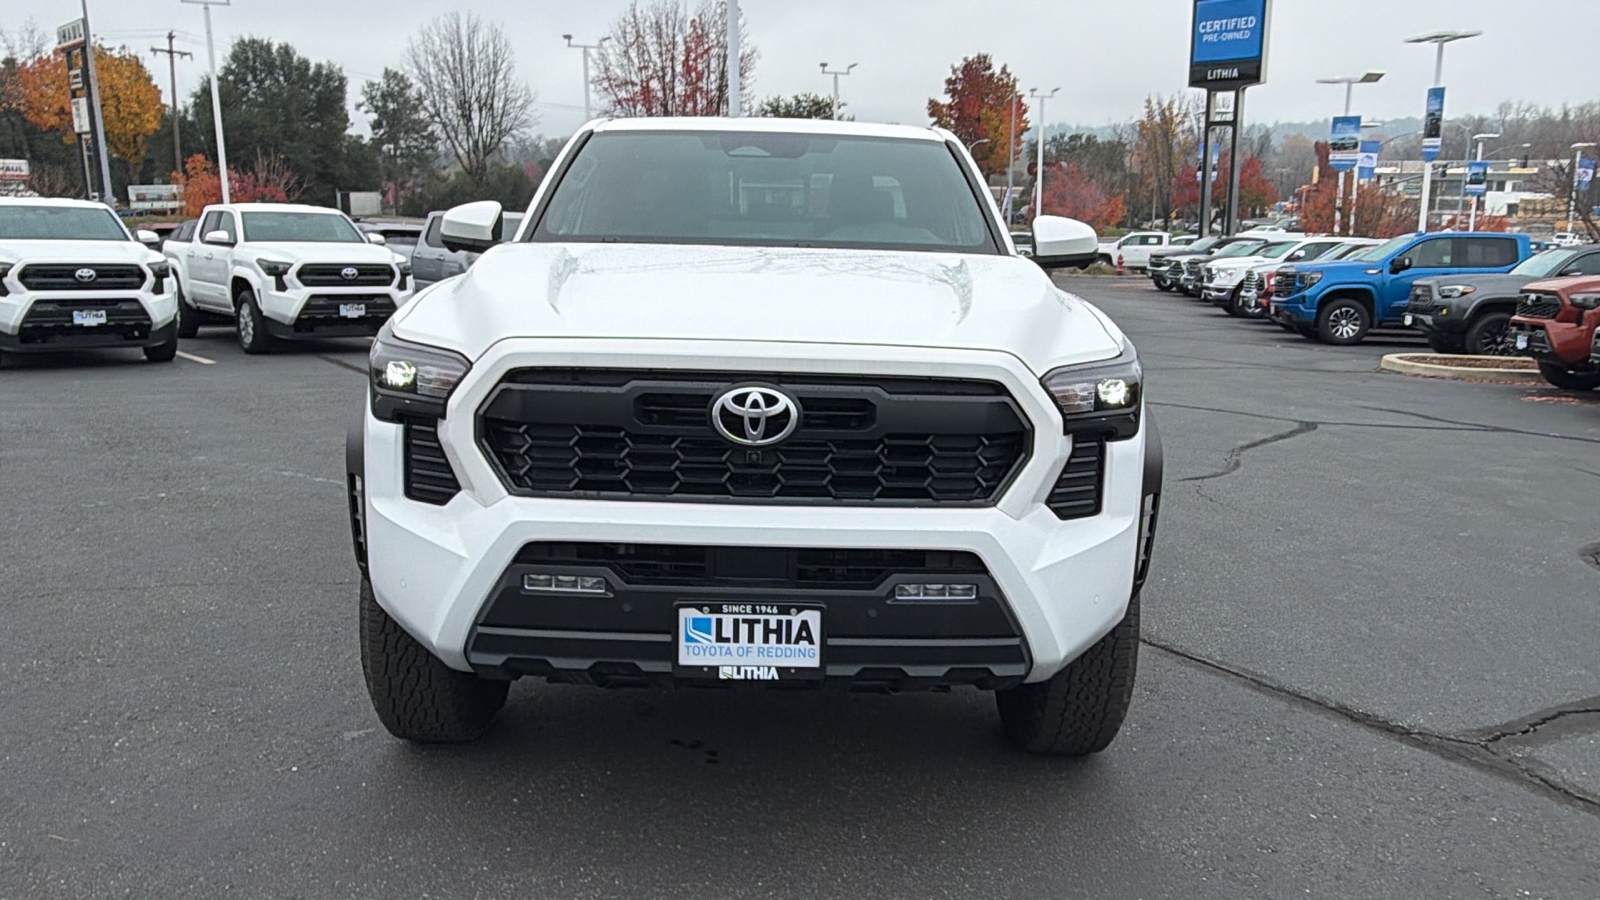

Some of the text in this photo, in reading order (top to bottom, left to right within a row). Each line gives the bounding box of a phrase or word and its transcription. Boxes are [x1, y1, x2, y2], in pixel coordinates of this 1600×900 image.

[1199, 16, 1256, 33] CERTIFIED
[1202, 30, 1251, 42] PRE-OWNED
[1207, 68, 1239, 80] LITHIA
[722, 604, 778, 614] SINCE 1946
[715, 617, 815, 645] LITHIA
[684, 645, 816, 658] TOYOTA OF REDDING
[732, 666, 779, 680] LITHIA
